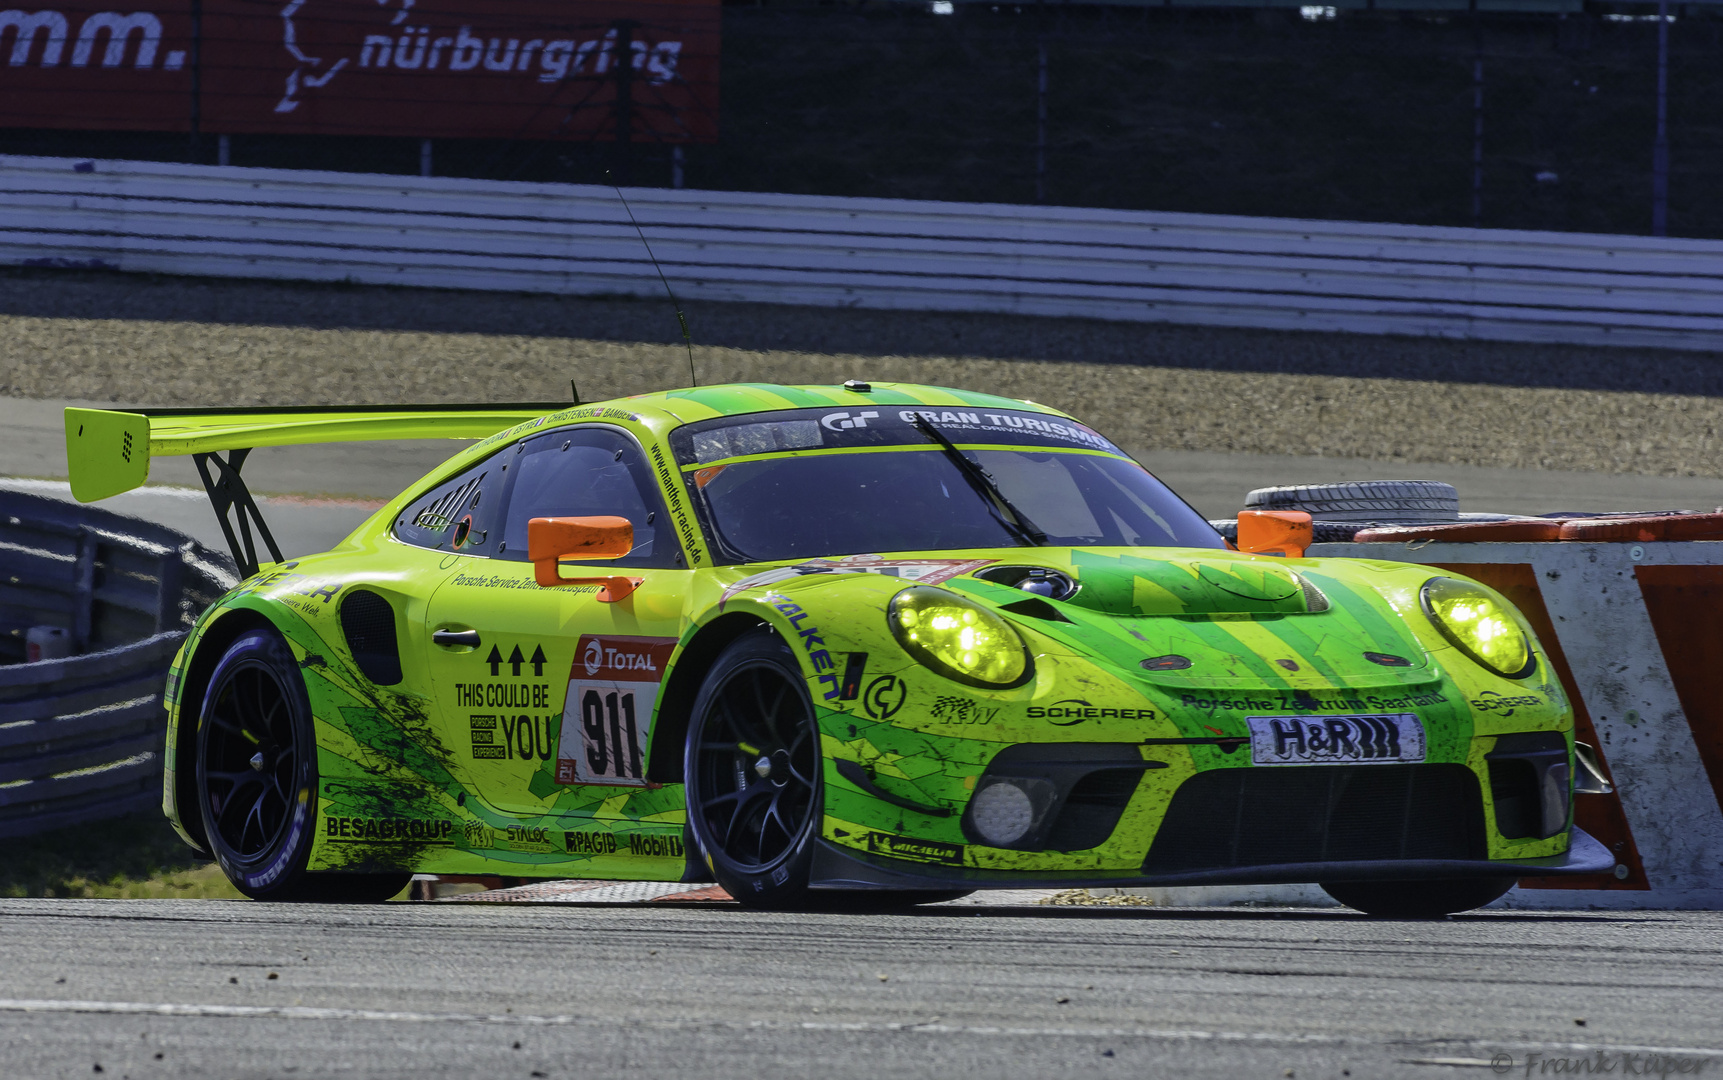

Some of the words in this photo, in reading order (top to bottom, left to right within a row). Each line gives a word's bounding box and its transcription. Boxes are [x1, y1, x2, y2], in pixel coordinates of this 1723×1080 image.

[547, 409, 595, 424] CHRISTENSEN
[910, 422, 939, 430] TE
[898, 410, 980, 425] GRAN
[984, 413, 1111, 450] TURISMO
[651, 443, 702, 565] www.manthey-racing.de
[451, 574, 485, 587] Porsche
[485, 575, 519, 589] Service
[517, 577, 552, 592] Zent
[280, 597, 301, 611] nsere
[301, 602, 320, 618] Welt,
[605, 648, 657, 672] TOTAL
[455, 684, 483, 707] THIS
[486, 684, 530, 708] COULD
[532, 684, 549, 708] BE
[1182, 693, 1273, 712] Porsche
[1275, 696, 1369, 711] Zetrum
[1371, 690, 1450, 709] Saarland
[1470, 695, 1544, 711] SCHERER
[472, 717, 495, 727] PORSCHE
[1027, 706, 1155, 720] SCHERER
[500, 715, 552, 761] YOU
[582, 690, 643, 779] 911
[1270, 719, 1358, 759] H&R
[474, 747, 504, 757] EXPERIENCE
[326, 817, 452, 839] BESAGROUP
[506, 824, 550, 844] STALOC
[576, 832, 617, 854] PAGID
[630, 833, 668, 857] Mobil
[893, 842, 957, 858] MICHELIN
